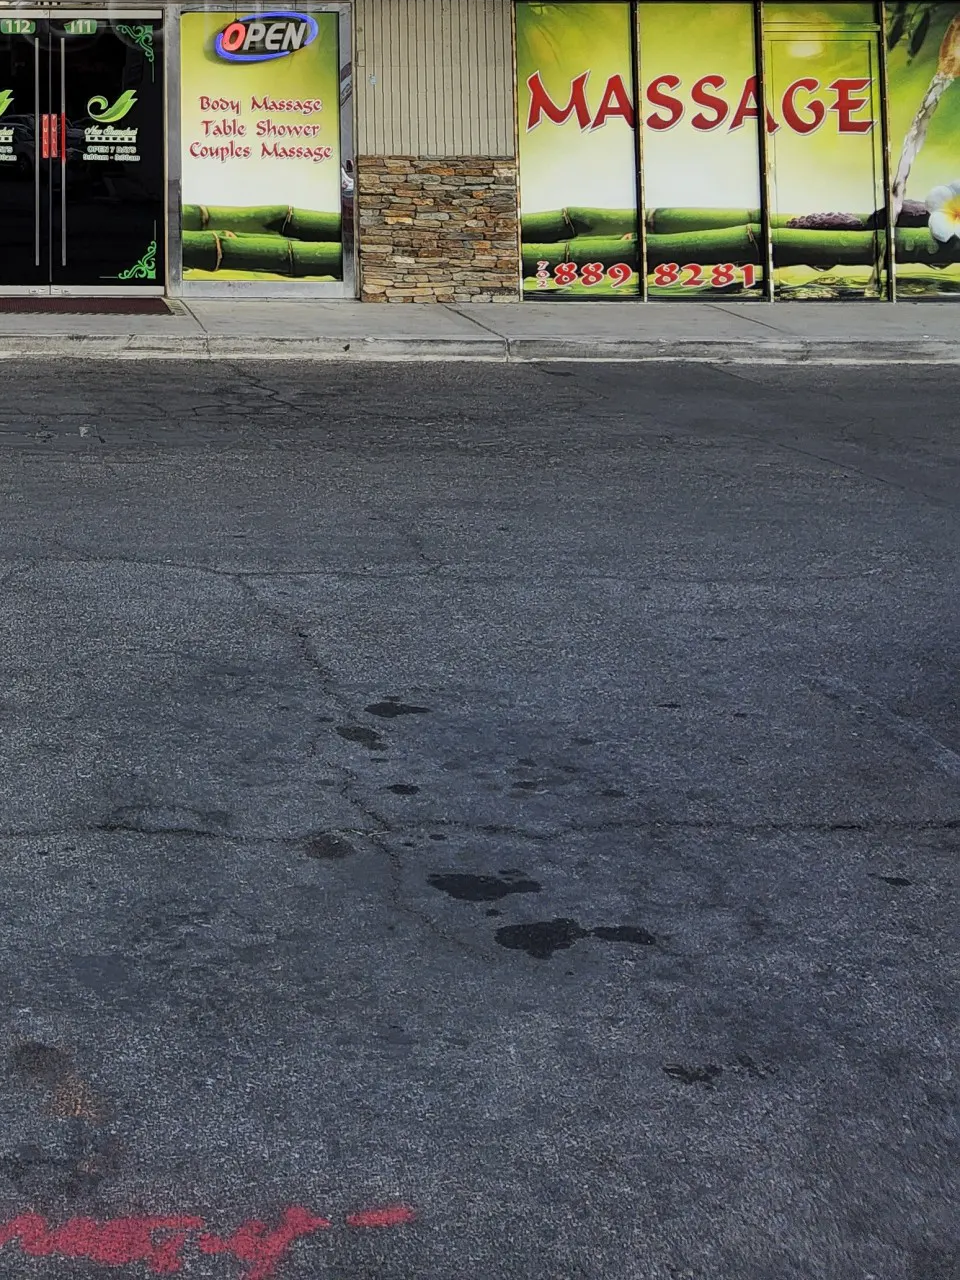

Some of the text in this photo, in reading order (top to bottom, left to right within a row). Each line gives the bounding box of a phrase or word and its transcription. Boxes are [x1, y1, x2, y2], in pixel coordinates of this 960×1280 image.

[5, 20, 31, 33] 112
[70, 20, 92, 33] 111
[222, 23, 307, 51] OPEN
[199, 95, 322, 115] Body Massage
[525, 71, 878, 135] MASSAGE
[201, 119, 320, 137] Table Shower
[189, 140, 333, 162] Couples Massage
[554, 262, 633, 288] 889
[654, 262, 756, 289] 8281
